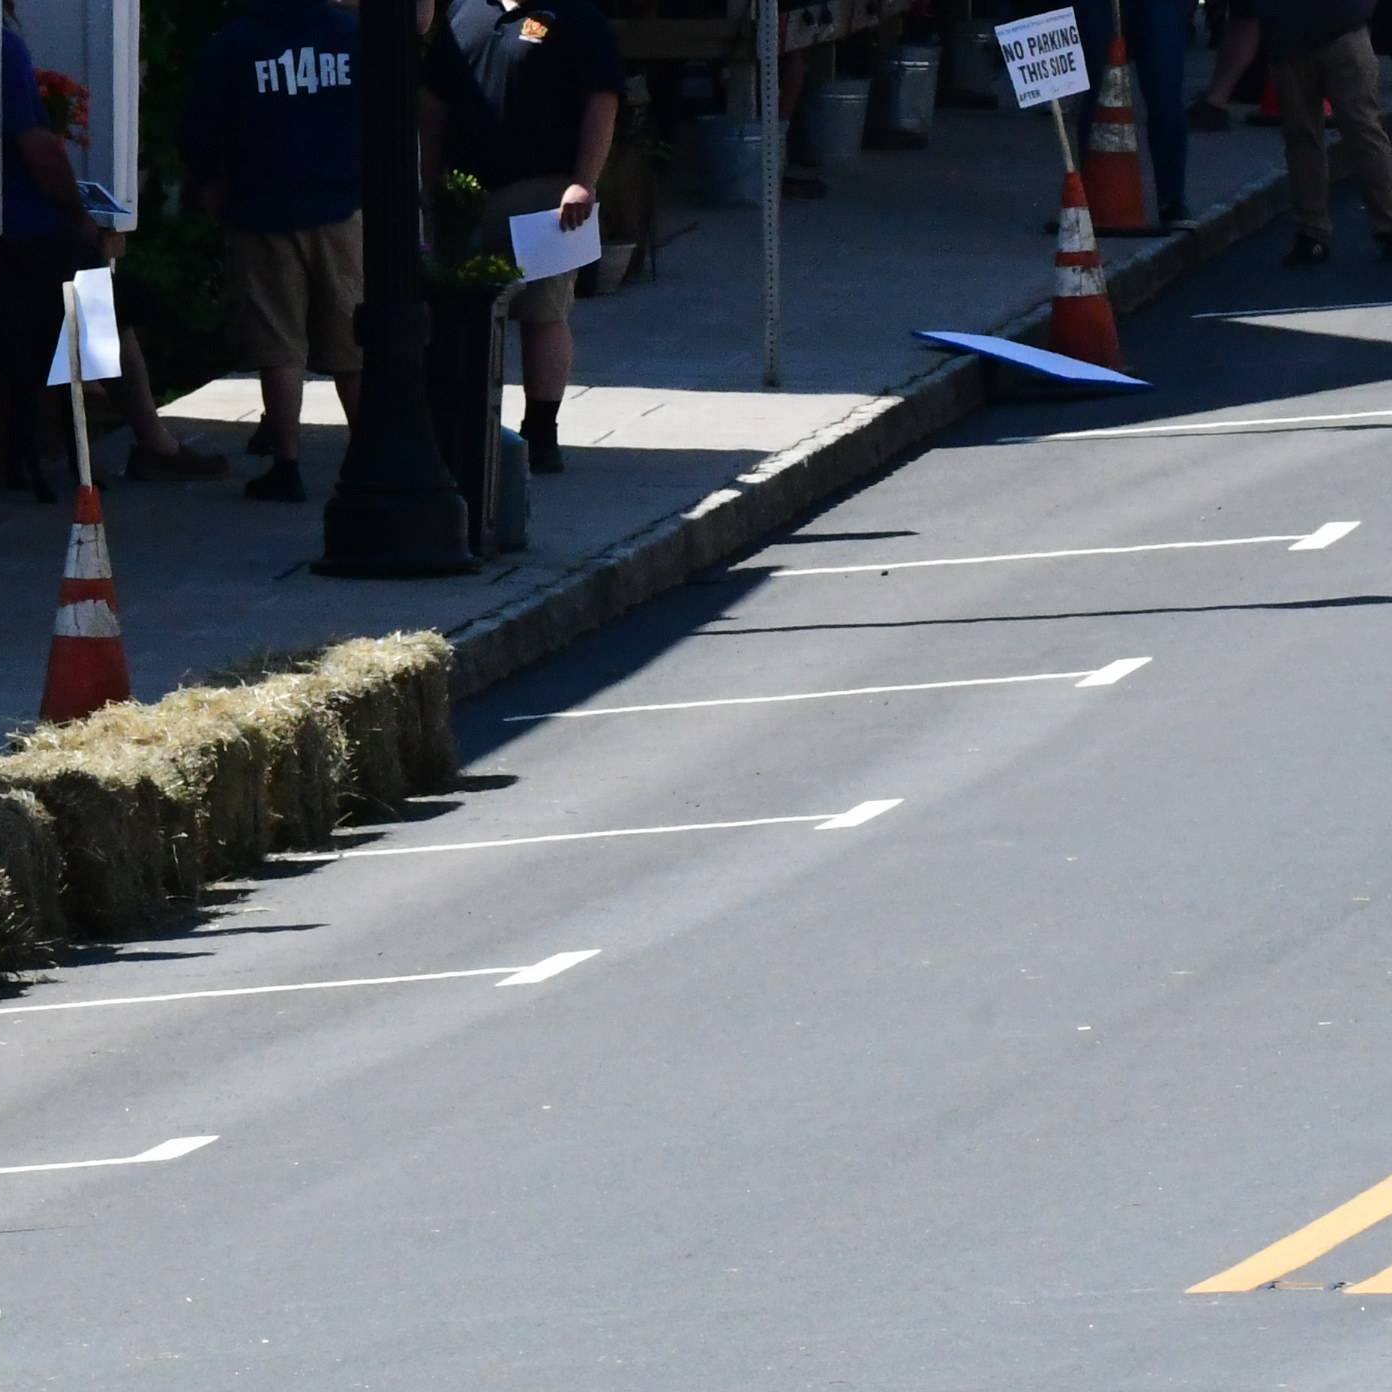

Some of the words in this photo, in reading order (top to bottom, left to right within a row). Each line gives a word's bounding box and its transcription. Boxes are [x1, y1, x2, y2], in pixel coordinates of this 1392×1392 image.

[1002, 40, 1024, 63] NO
[1027, 25, 1079, 57] PARKING
[1017, 59, 1049, 84] THIS
[1049, 52, 1076, 77] SIDE
[1019, 89, 1041, 102] AFTER
